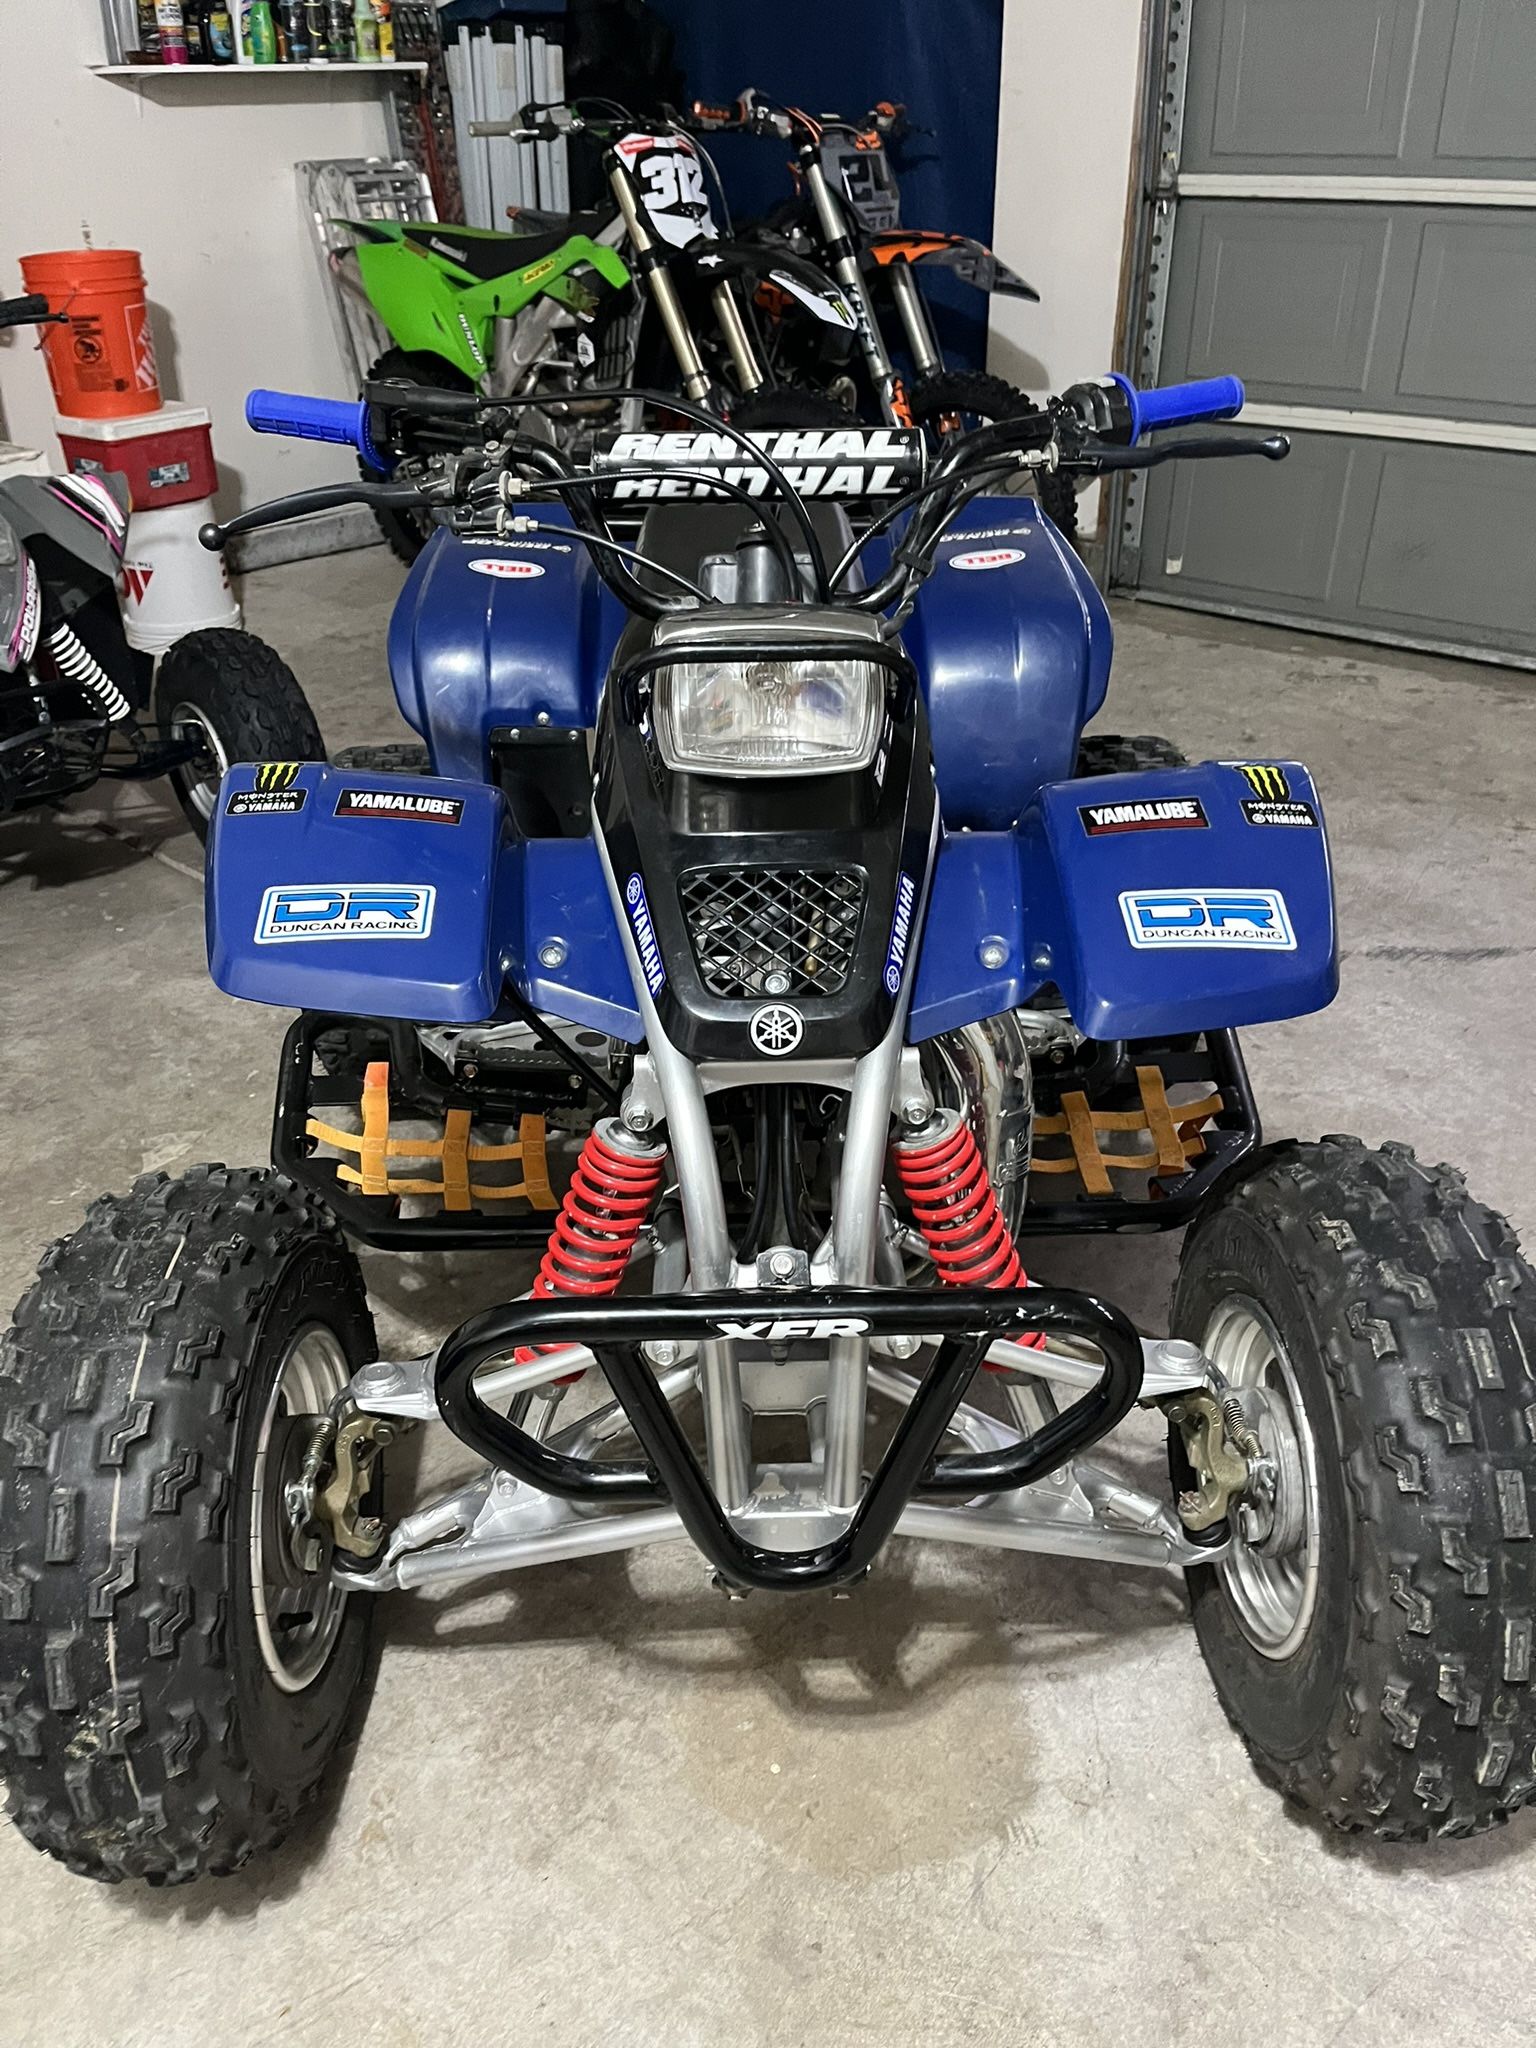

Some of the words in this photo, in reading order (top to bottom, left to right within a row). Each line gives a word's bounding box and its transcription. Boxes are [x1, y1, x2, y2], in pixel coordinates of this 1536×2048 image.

[608, 431, 907, 460] RENTHAL
[612, 465, 903, 499] RENTHAL
[248, 801, 296, 812] YAMAHA
[349, 793, 454, 815] YAMALUBE
[1088, 801, 1198, 826] YAMALUBE
[1264, 814, 1313, 825] YAMAHA
[272, 892, 420, 923] DR
[1134, 897, 1277, 929] DR
[269, 922, 347, 934] DUNCAN
[350, 921, 419, 931] RACING
[890, 875, 915, 968] YAMAHA
[1142, 928, 1216, 939] DUNCAN
[1219, 928, 1283, 940] RACING
[632, 898, 664, 995] YAMAHA
[715, 1317, 869, 1340] XFR
